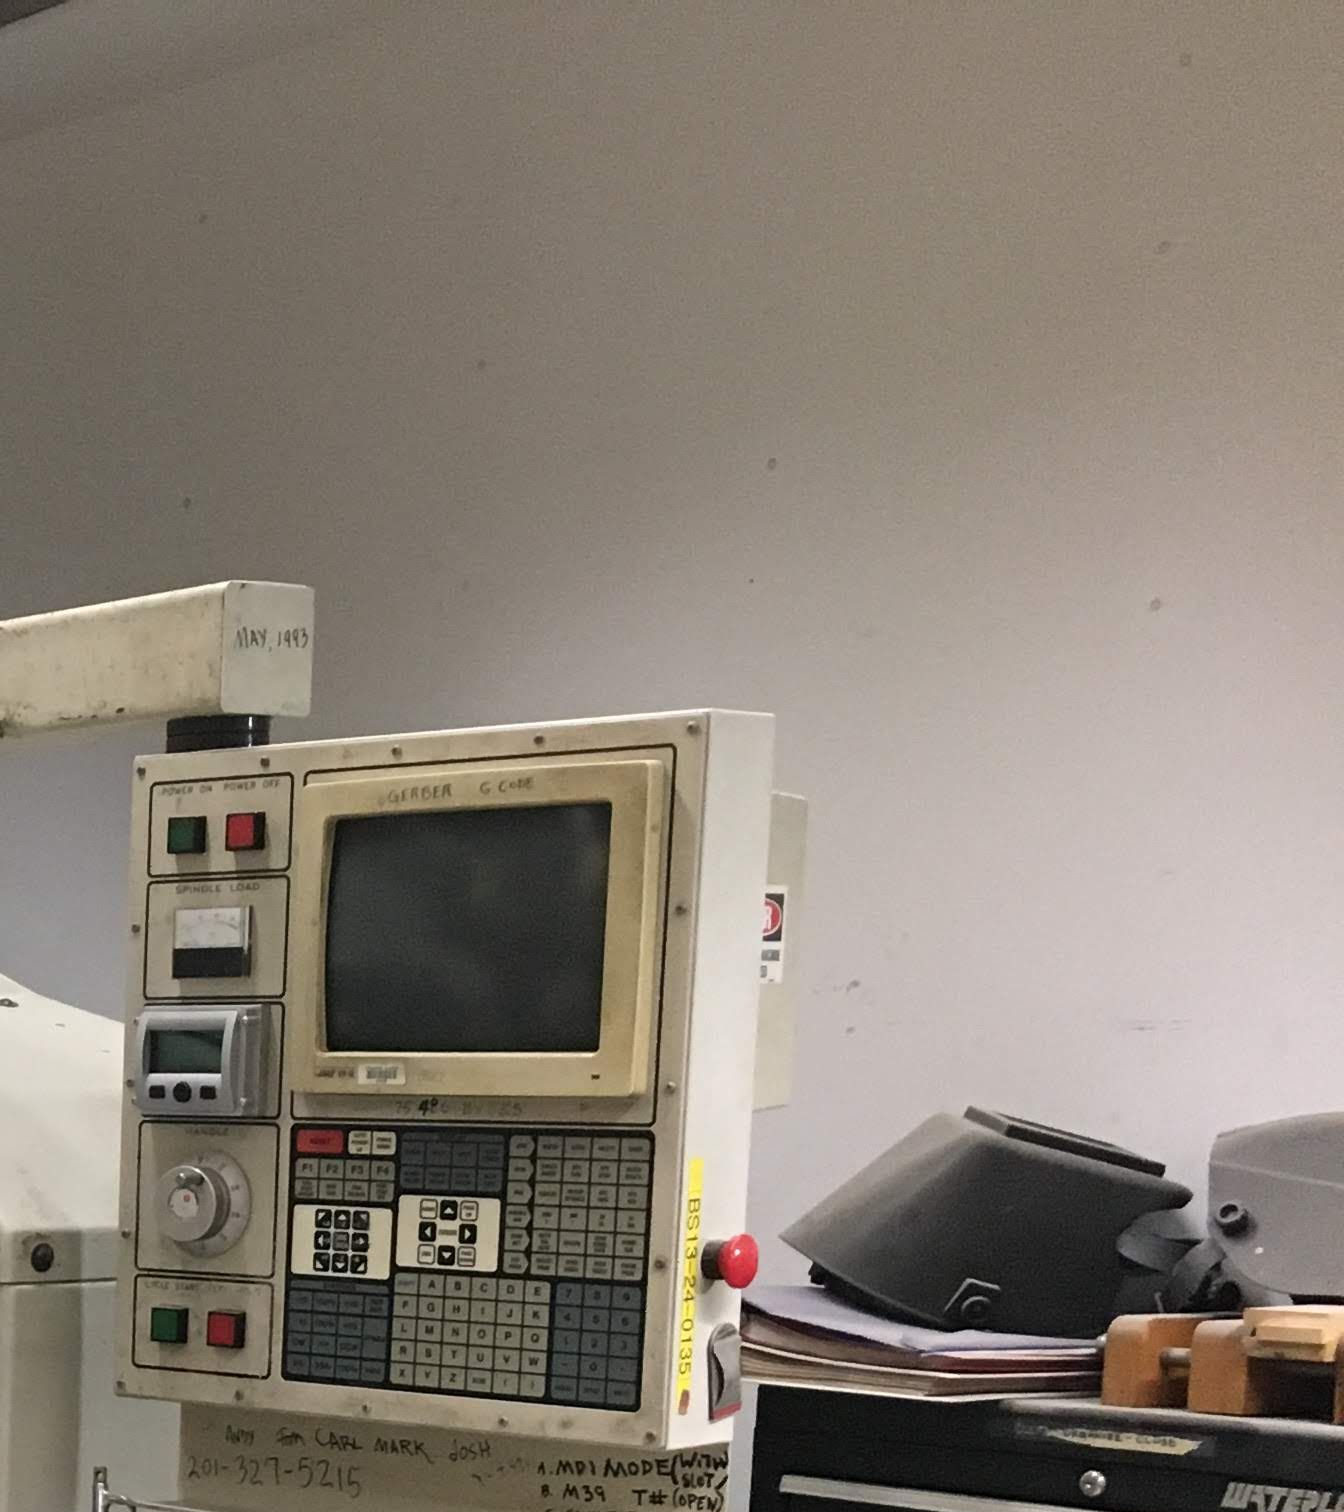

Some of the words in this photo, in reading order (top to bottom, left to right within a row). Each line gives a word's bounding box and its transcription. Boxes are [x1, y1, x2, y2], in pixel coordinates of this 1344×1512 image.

[278, 627, 309, 649] 1993
[162, 785, 194, 797] POWER
[199, 784, 213, 794] ON
[223, 781, 256, 792] POWER
[262, 779, 280, 789] OFF
[386, 783, 453, 804] GERBER
[479, 780, 491, 795] G
[175, 884, 222, 896] SPINDLE
[229, 882, 260, 893] LOAD
[301, 1163, 313, 1173] F1
[325, 1163, 339, 1174] F2
[376, 1165, 390, 1176] F4
[428, 1279, 436, 1290] A
[479, 1283, 489, 1293] C
[507, 1284, 515, 1294] D
[534, 1286, 542, 1296] E
[678, 1197, 701, 1376] BS13-24-0135
[402, 1300, 408, 1310] F
[427, 1303, 435, 1313] G
[452, 1305, 461, 1314] H
[506, 1308, 513, 1318] J
[532, 1310, 540, 1320] K
[400, 1323, 407, 1333] L
[425, 1325, 434, 1334] M
[451, 1327, 460, 1336] N
[477, 1329, 486, 1339] O
[504, 1331, 512, 1340] P
[530, 1333, 540, 1344] Q
[450, 1350, 457, 1359] T
[476, 1352, 484, 1362] U
[503, 1354, 510, 1364] V
[528, 1357, 539, 1366] W
[399, 1369, 406, 1377] X
[449, 1373, 457, 1383] Z
[315, 1426, 363, 1451] CARL
[373, 1437, 435, 1465] MARK
[187, 1454, 361, 1499] 201-327-5215
[555, 1459, 596, 1477] MDI
[603, 1457, 671, 1478] MODE
[562, 1484, 606, 1502] M39
